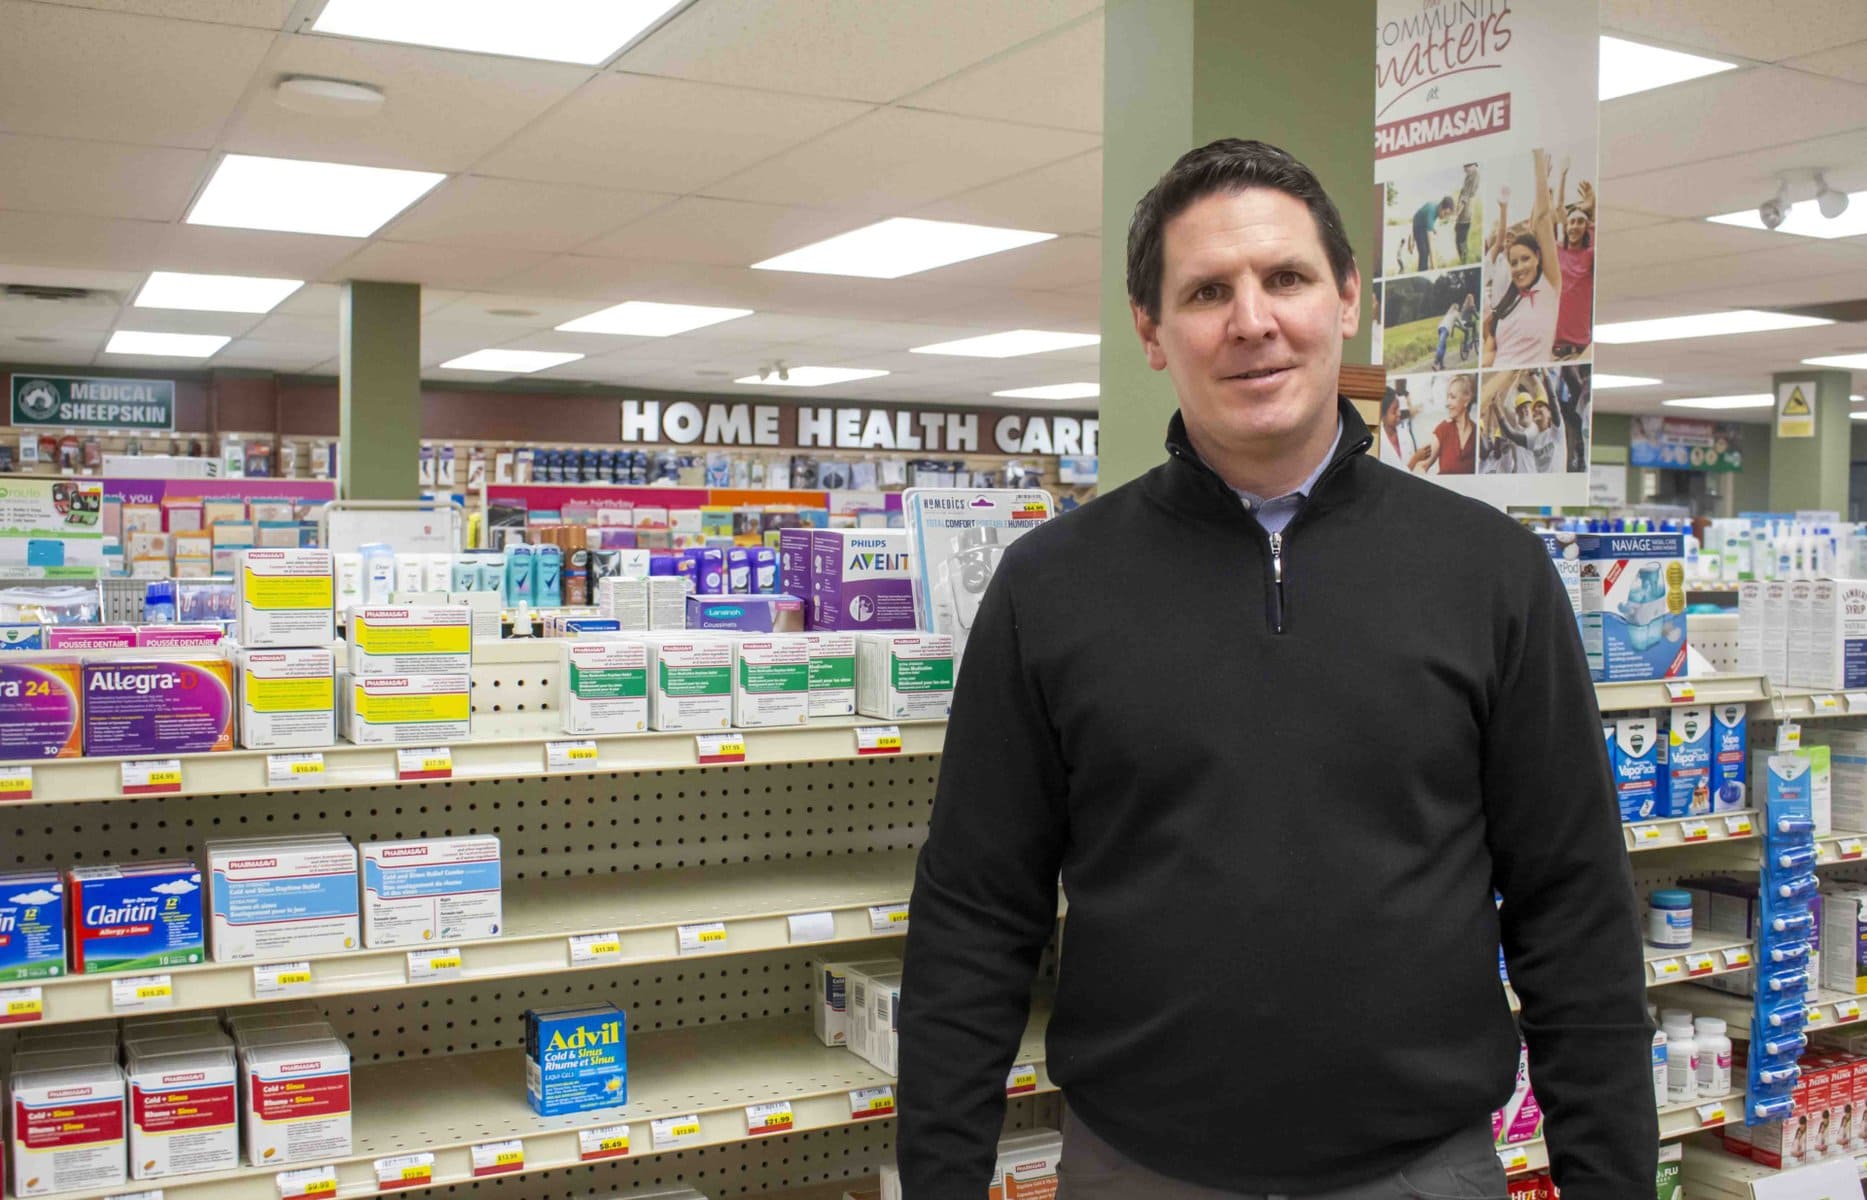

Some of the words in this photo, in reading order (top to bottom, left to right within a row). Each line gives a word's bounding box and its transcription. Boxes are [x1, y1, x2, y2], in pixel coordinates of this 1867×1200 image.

[70, 382, 157, 402] MEDICAL
[59, 402, 166, 424] SHEEPSKIN
[621, 400, 780, 445] HOME
[798, 407, 978, 451] HEALTH
[945, 520, 974, 528] COMFORT
[851, 539, 887, 548] PHILIPS
[849, 553, 909, 571] AVENT
[58, 640, 91, 649] POUSSÉE
[93, 640, 129, 649] DENTAIRE
[89, 671, 198, 694] Allegra-D
[25, 681, 50, 696] 24
[44, 746, 58, 755] 30
[383, 849, 426, 857] PHARMASAVE
[230, 859, 276, 869] PHARMASAVE
[86, 904, 157, 926] Claritin
[99, 928, 126, 936] Allergy
[130, 926, 149, 934] Sinus
[544, 1021, 621, 1052] Advil
[544, 1051, 567, 1061] Cold
[568, 1050, 576, 1059] &
[578, 1048, 603, 1058] Sinus
[281, 1062, 320, 1072] PHARMASAVE
[545, 1060, 578, 1071] Rhume
[579, 1058, 589, 1066] et
[590, 1055, 615, 1066] Sinus
[263, 1085, 279, 1093] Cold
[286, 1083, 305, 1091] Sinus
[144, 1097, 161, 1105] Cold
[167, 1094, 188, 1102] Sinus
[295, 1095, 315, 1103] Sinus
[27, 1112, 46, 1121] Cold
[53, 1110, 75, 1118] Sinus
[177, 1107, 198, 1115] Sinus
[63, 1123, 84, 1131] Sinus
[599, 1141, 622, 1151] $8.49
[1664, 1166, 1679, 1177] FLU
